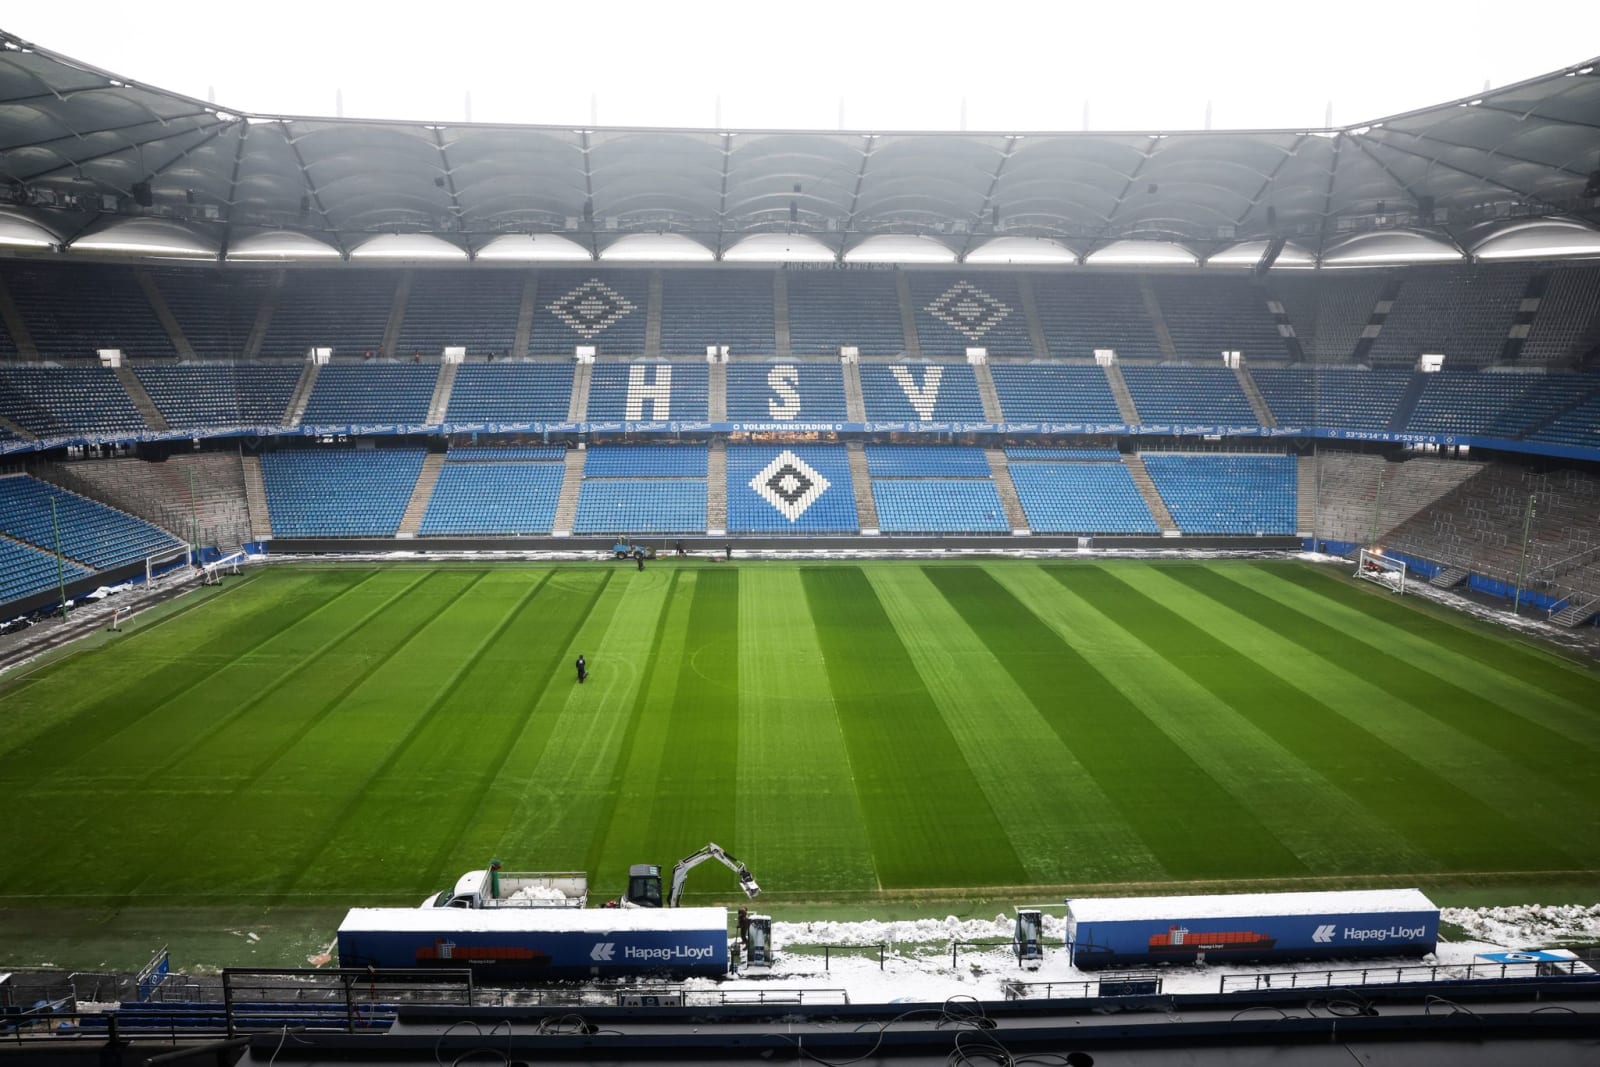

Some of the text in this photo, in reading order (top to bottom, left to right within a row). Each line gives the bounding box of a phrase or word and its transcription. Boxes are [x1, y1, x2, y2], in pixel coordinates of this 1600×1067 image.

[625, 364, 945, 421] H S V
[743, 423, 833, 431] VOLKSPARKSTADION
[1382, 433, 1390, 441] N
[1344, 925, 1426, 941] Hapag-Lloyd
[624, 945, 713, 960] Hapag-Lloyd
